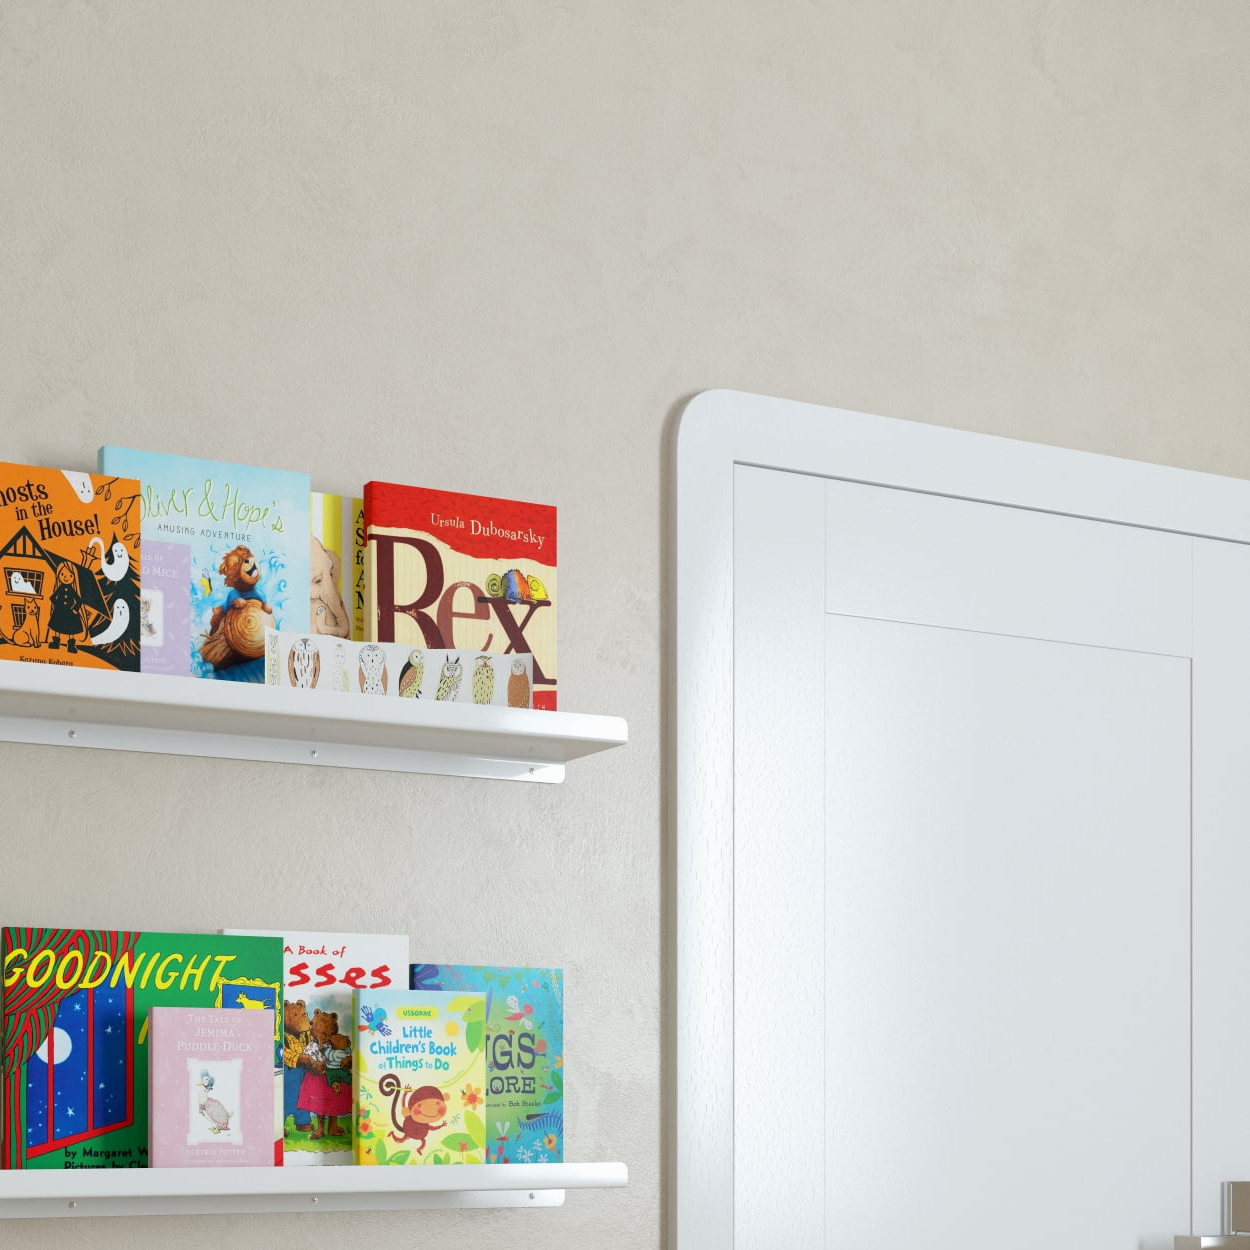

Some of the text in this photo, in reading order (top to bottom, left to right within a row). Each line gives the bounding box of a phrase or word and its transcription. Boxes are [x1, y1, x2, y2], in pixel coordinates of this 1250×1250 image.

[15, 501, 53, 520] in the
[198, 479, 219, 521] &
[222, 482, 284, 533] Hope's
[37, 513, 100, 541] House!
[157, 523, 252, 542] AMUSING ADVENTURE
[430, 512, 545, 550] Ursula Dubosarsky
[367, 533, 557, 686] Rex
[284, 945, 347, 958] A Book of
[4, 948, 237, 992] GOODNIGHT
[284, 962, 392, 989] sses
[194, 1027, 235, 1038] JEMIMA
[402, 1026, 433, 1039] Little
[177, 1040, 254, 1053] PUDDLE-DUCK
[369, 1040, 458, 1056] Children's Book
[486, 1032, 537, 1071] GS
[378, 1056, 450, 1072] of Things to Do
[486, 1076, 536, 1096] ORE
[64, 1146, 77, 1159] by
[83, 1147, 133, 1159] Margaret
